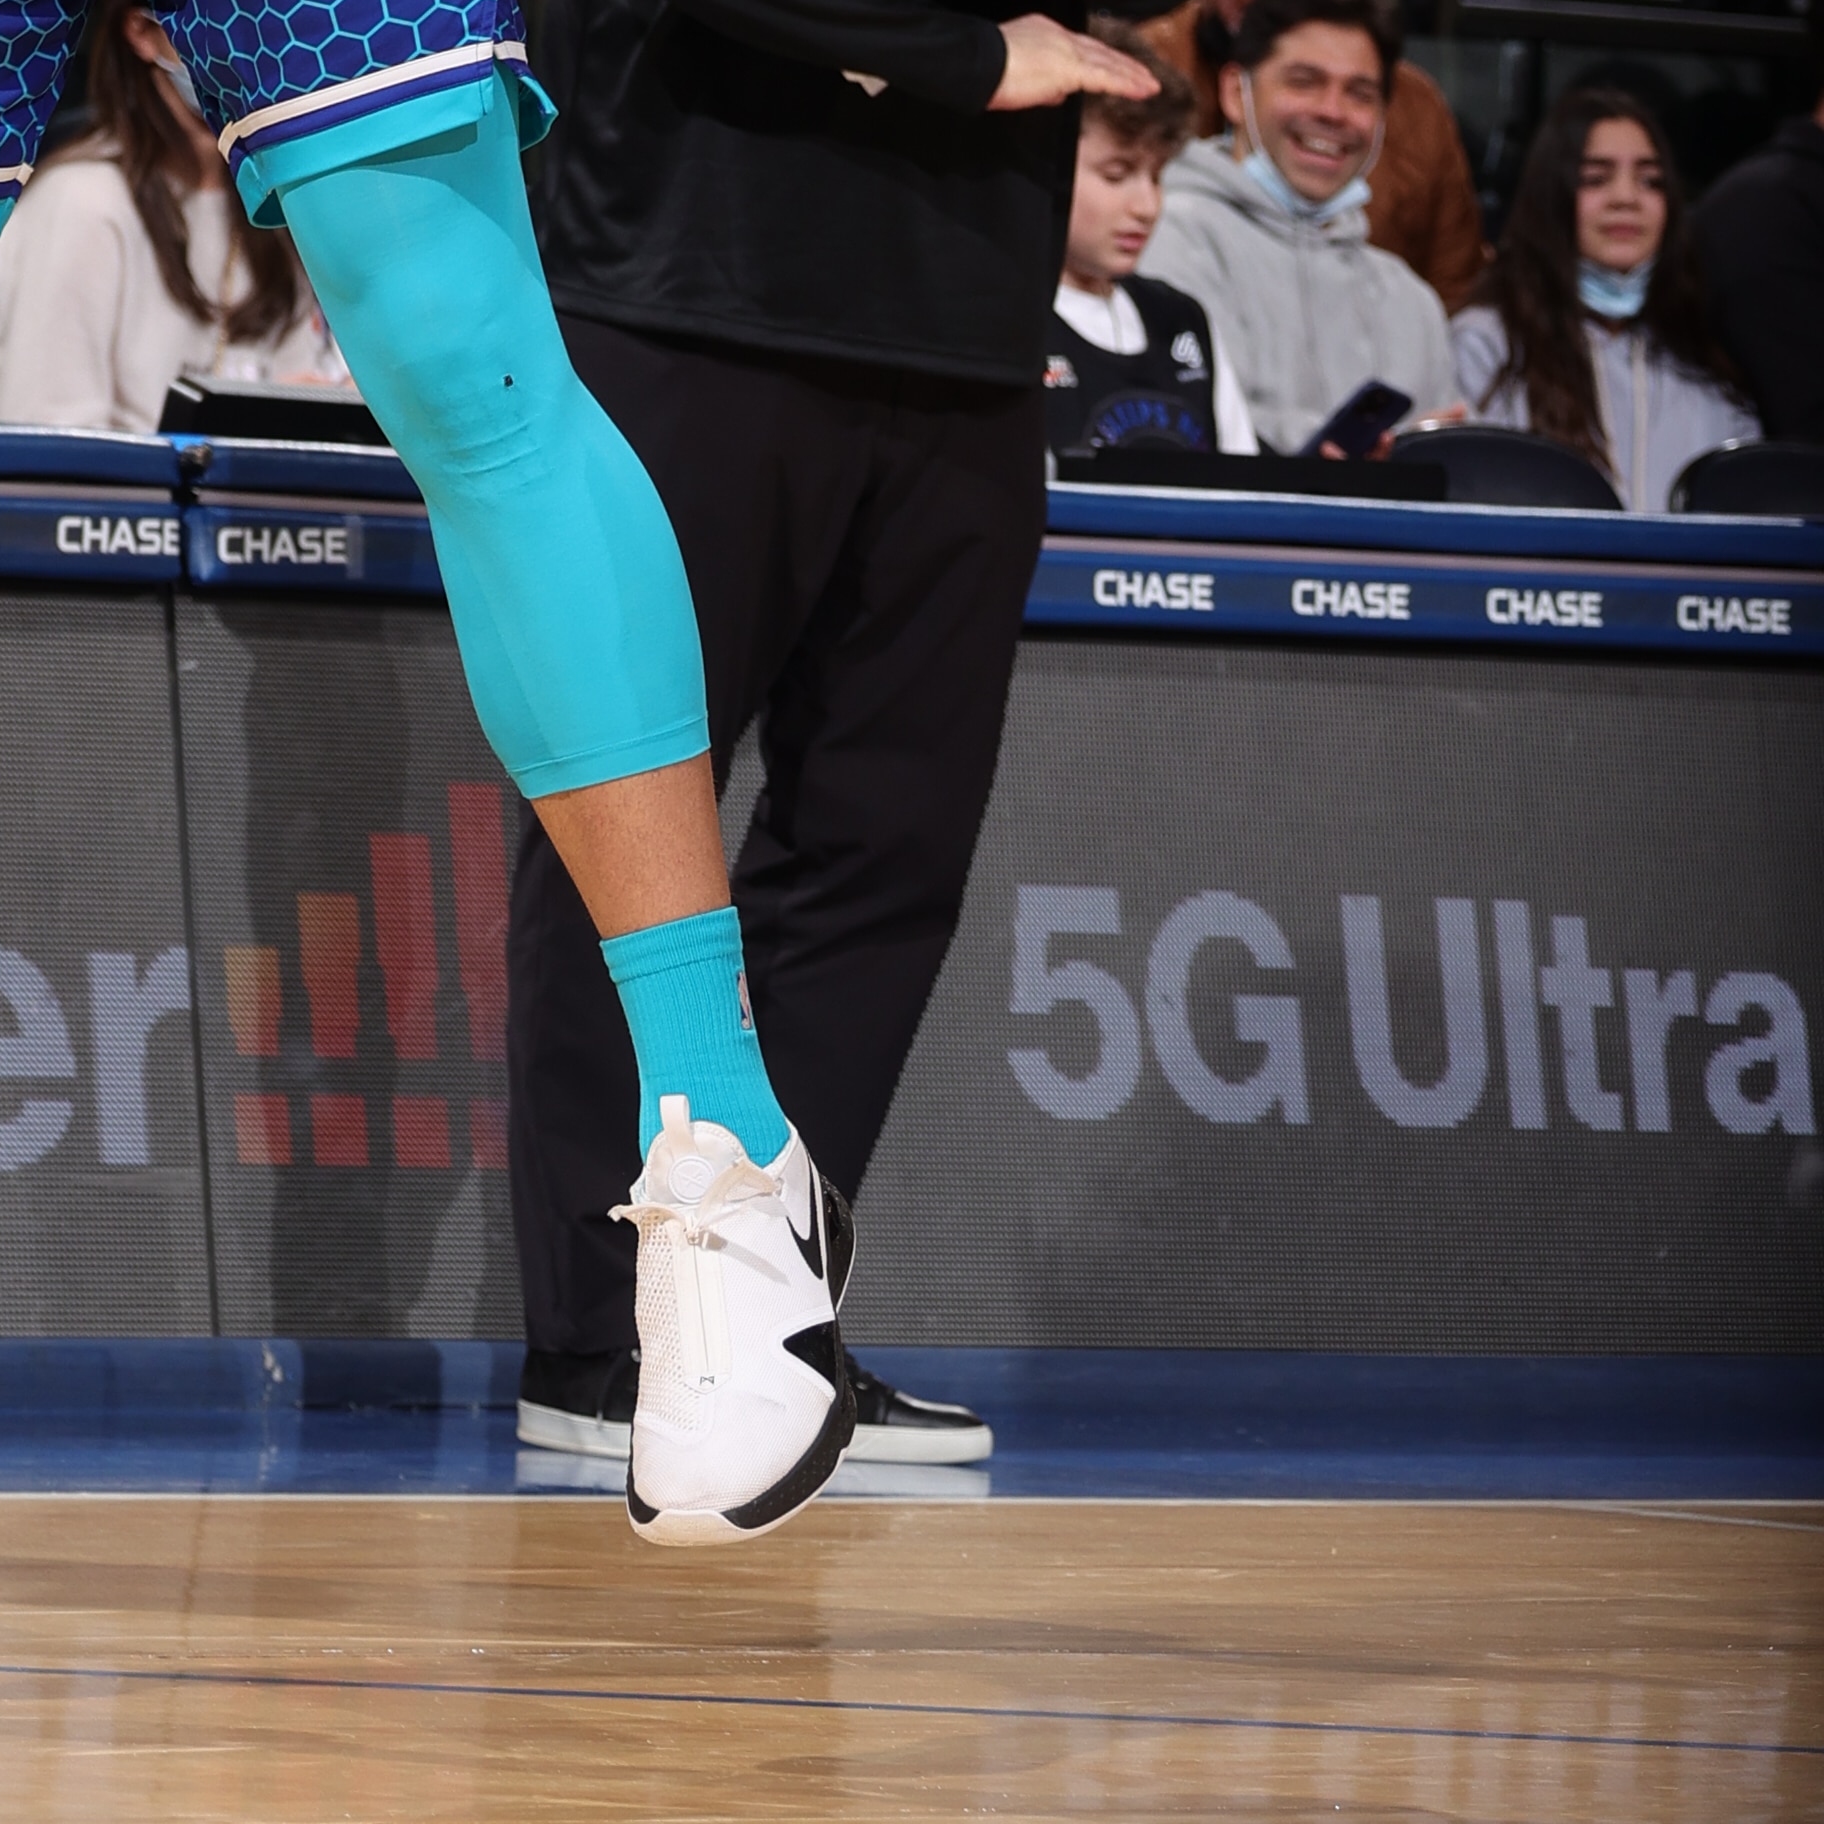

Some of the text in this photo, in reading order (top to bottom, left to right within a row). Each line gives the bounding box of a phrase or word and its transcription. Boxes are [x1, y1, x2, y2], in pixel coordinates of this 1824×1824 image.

[56, 514, 180, 557] CHASE
[216, 525, 349, 566] CHASE
[1092, 567, 1216, 614] CHASE
[1290, 578, 1412, 622] CHASE
[1484, 587, 1605, 629] CHASE
[1675, 594, 1793, 637] CHASE
[1005, 883, 1312, 1126] 5G
[1339, 892, 1819, 1137] Ultra
